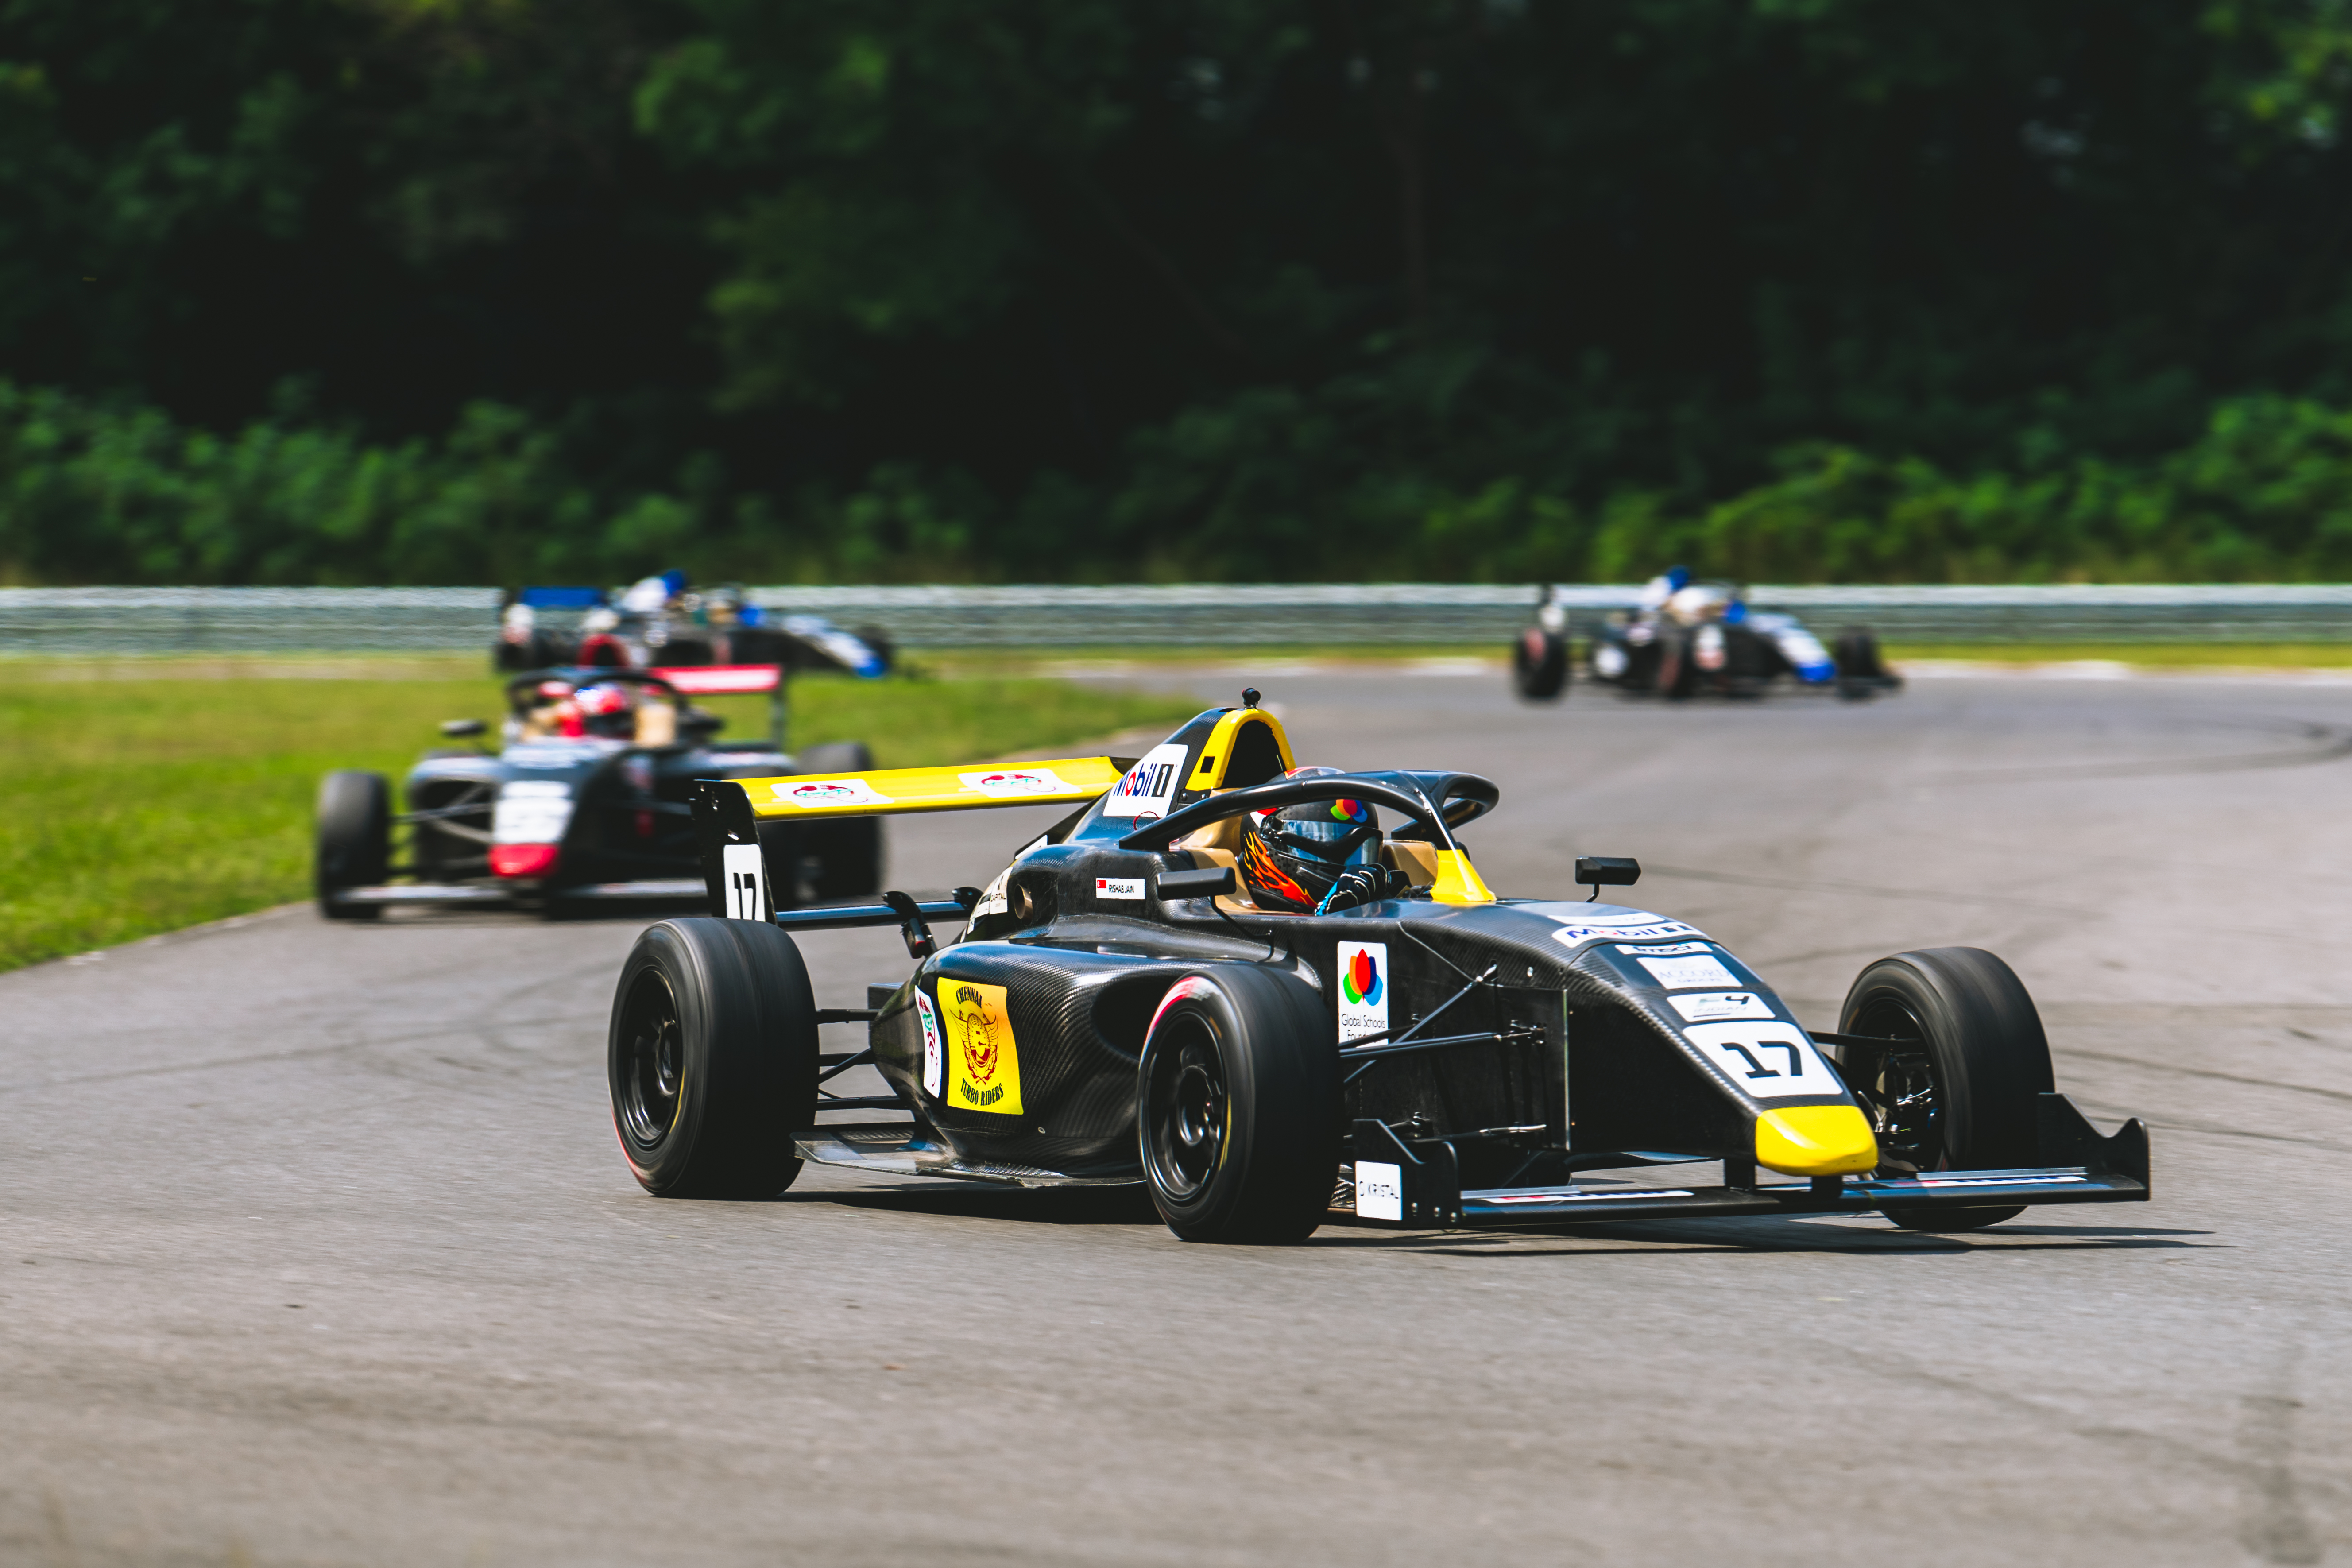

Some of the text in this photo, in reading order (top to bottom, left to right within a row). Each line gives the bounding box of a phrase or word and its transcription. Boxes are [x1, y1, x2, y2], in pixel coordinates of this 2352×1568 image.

[1113, 763, 1172, 797] Mobil 1
[733, 872, 757, 920] 17
[1566, 928, 1659, 939] Mobil
[1659, 969, 1730, 979] ACCORD
[956, 986, 983, 1009] CHENNAI
[1341, 1013, 1386, 1029] Global Schools
[1720, 1041, 1803, 1079] 17
[960, 1077, 1004, 1106] TURBO RIDERS
